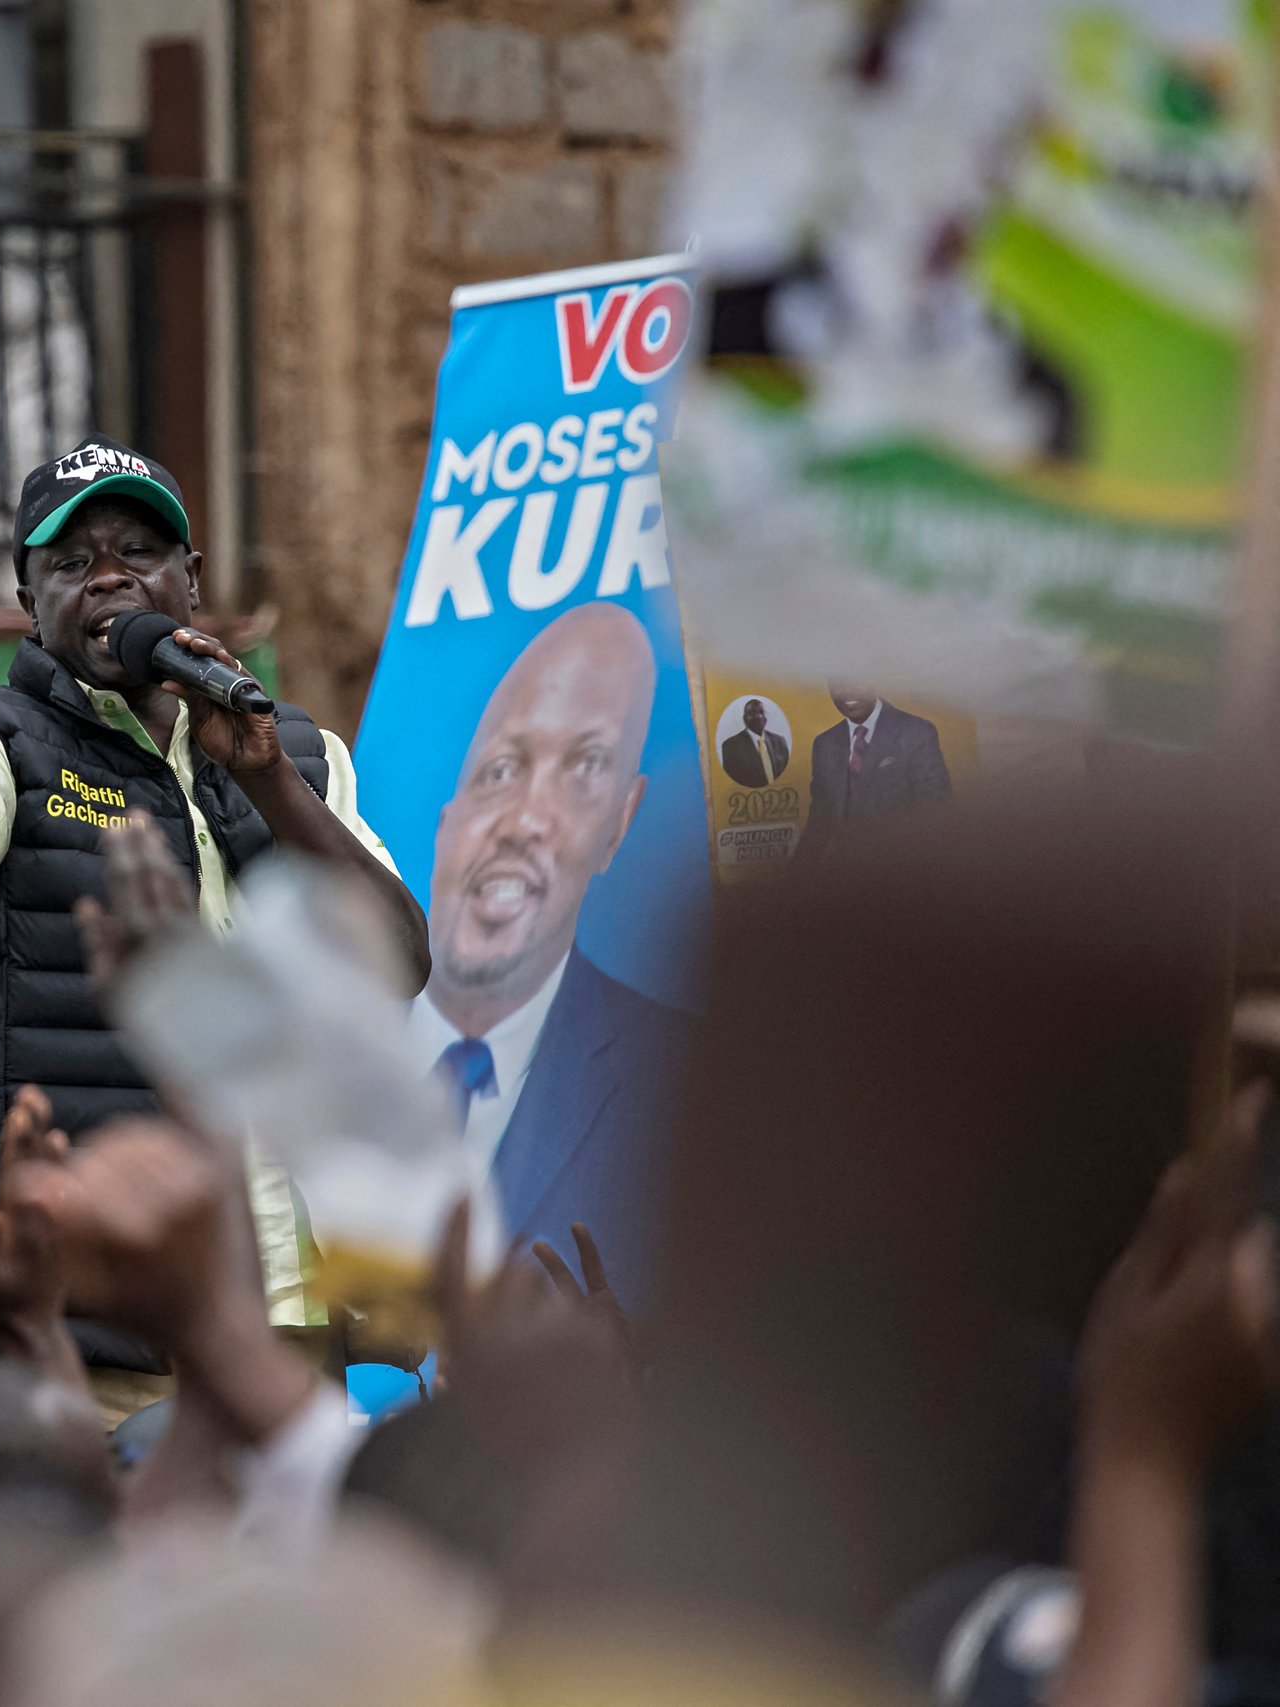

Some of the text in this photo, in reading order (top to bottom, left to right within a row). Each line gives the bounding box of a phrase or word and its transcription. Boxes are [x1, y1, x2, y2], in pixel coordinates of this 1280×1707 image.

[555, 276, 692, 394] VO
[61, 447, 151, 476] KENYA
[431, 403, 658, 502] MOSES
[61, 768, 125, 808] Rigathi
[728, 787, 799, 826] 2022
